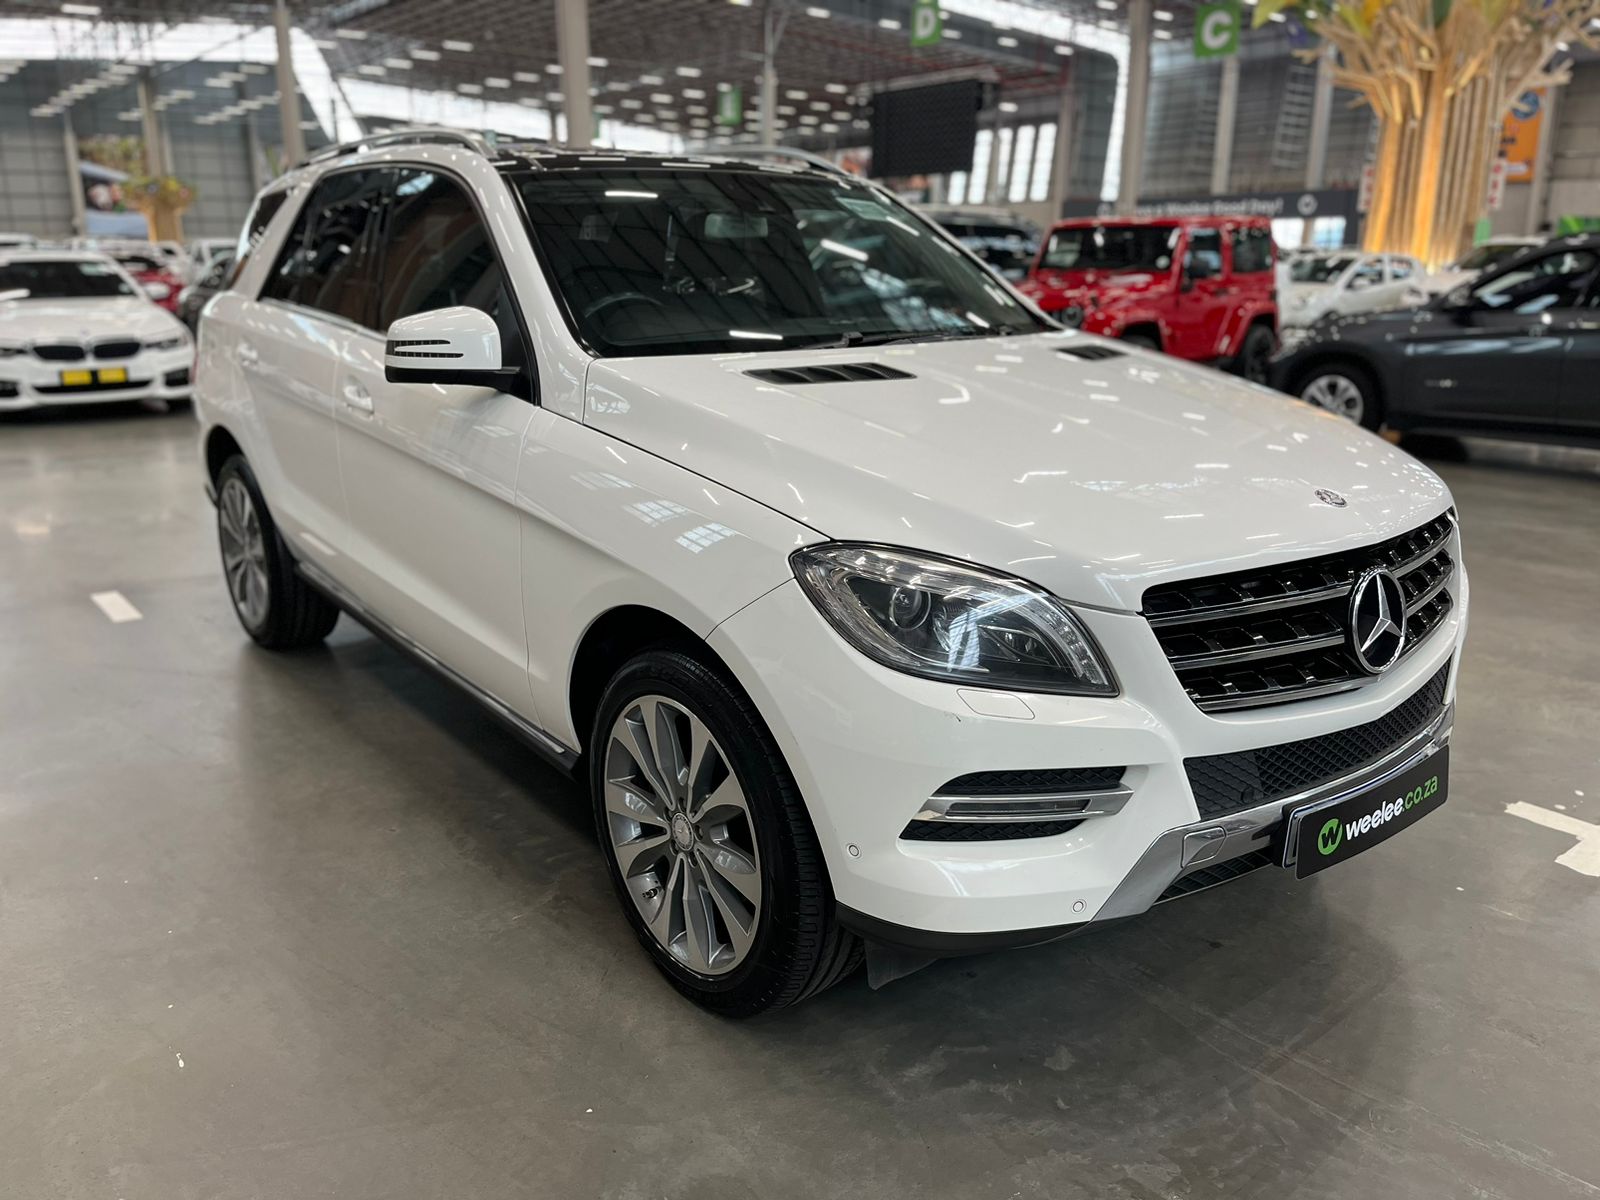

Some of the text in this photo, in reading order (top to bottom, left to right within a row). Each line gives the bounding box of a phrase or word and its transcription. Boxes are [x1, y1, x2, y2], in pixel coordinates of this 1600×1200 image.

[915, 7, 936, 38] D
[1202, 10, 1232, 49] C
[1345, 775, 1439, 841] weelee.co.za
